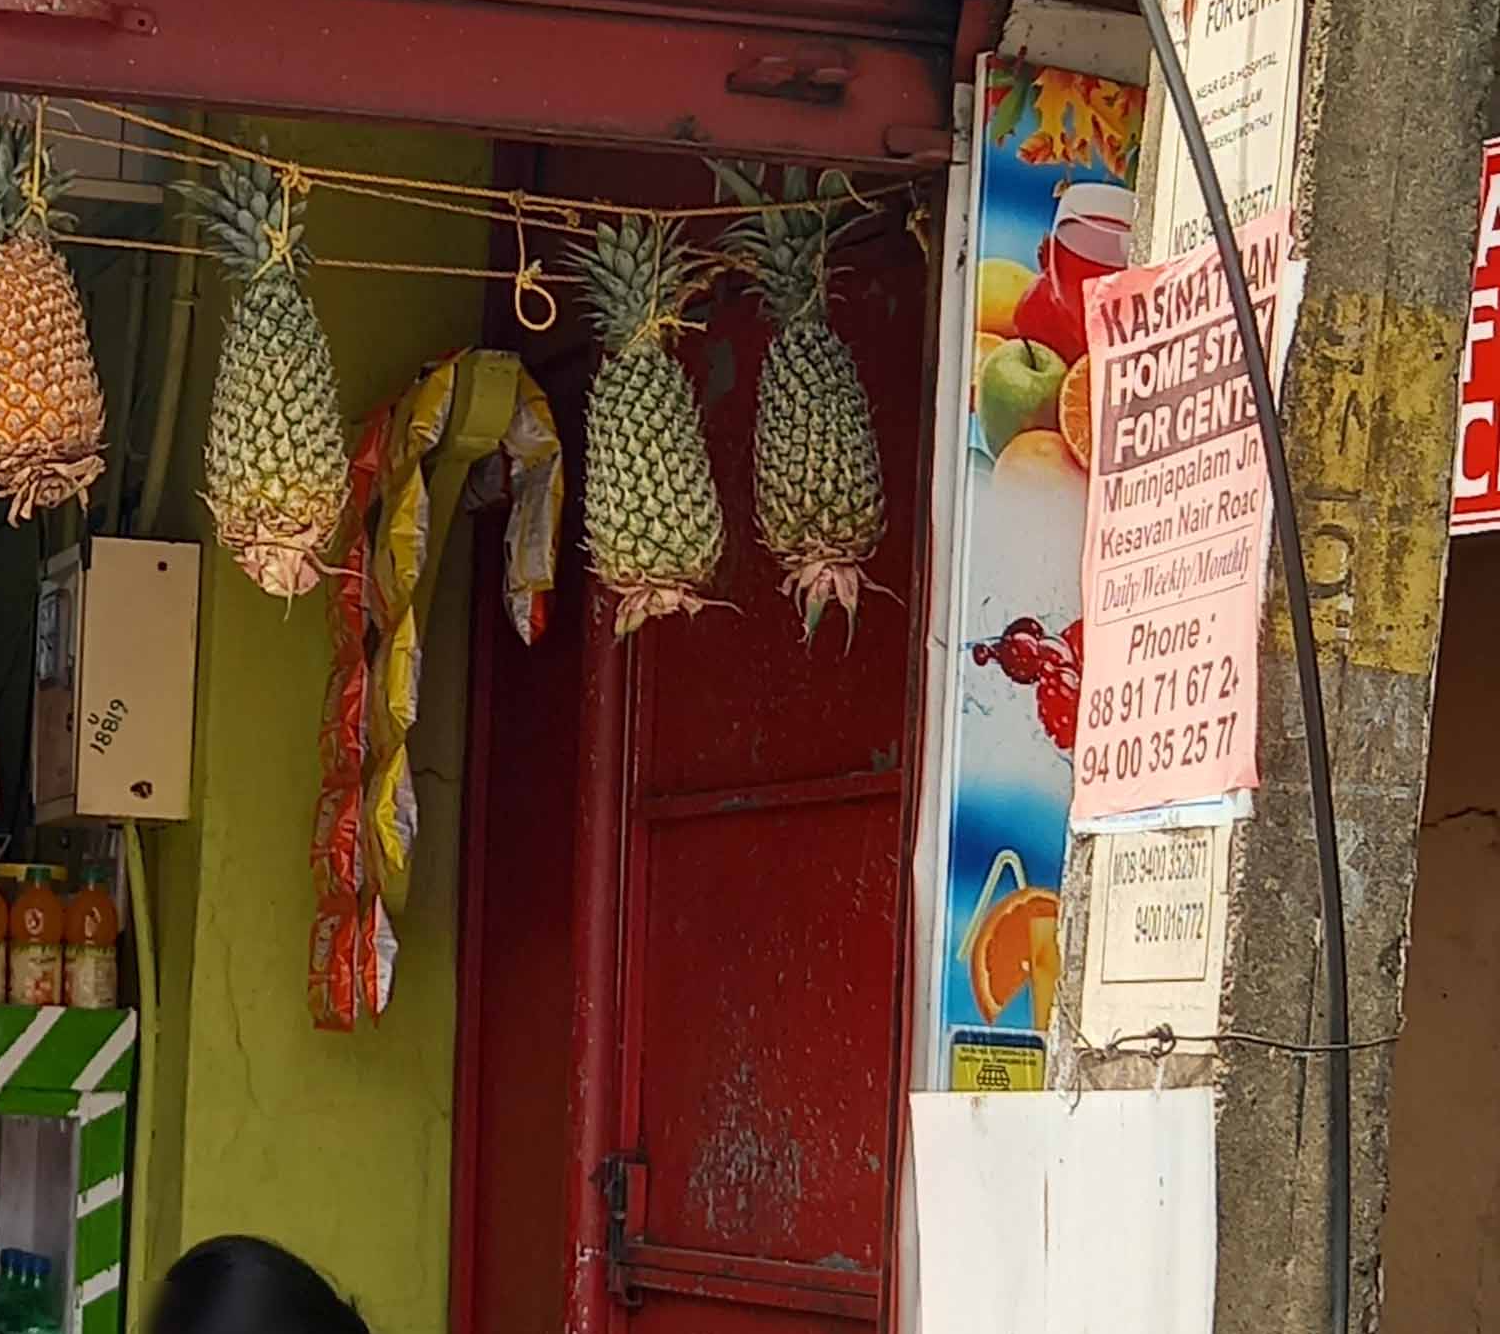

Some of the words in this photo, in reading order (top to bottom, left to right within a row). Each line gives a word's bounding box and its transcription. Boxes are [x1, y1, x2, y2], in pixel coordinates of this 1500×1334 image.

[1101, 231, 1280, 348] KASINATAN
[1109, 333, 1200, 407] HOME
[1113, 405, 1171, 465] FOR
[1103, 449, 1231, 514] Murinjapalam
[1101, 517, 1173, 560] Kesavan
[1178, 499, 1213, 537] Nair
[1127, 618, 1201, 665] Phone
[1088, 686, 1114, 729] 88
[1120, 676, 1145, 722] 91
[1154, 669, 1178, 715] 71
[1186, 660, 1214, 706] 67
[1081, 743, 1109, 785] 94
[1116, 736, 1142, 780] 00
[1148, 728, 1175, 772] 35
[1180, 721, 1209, 766] 25
